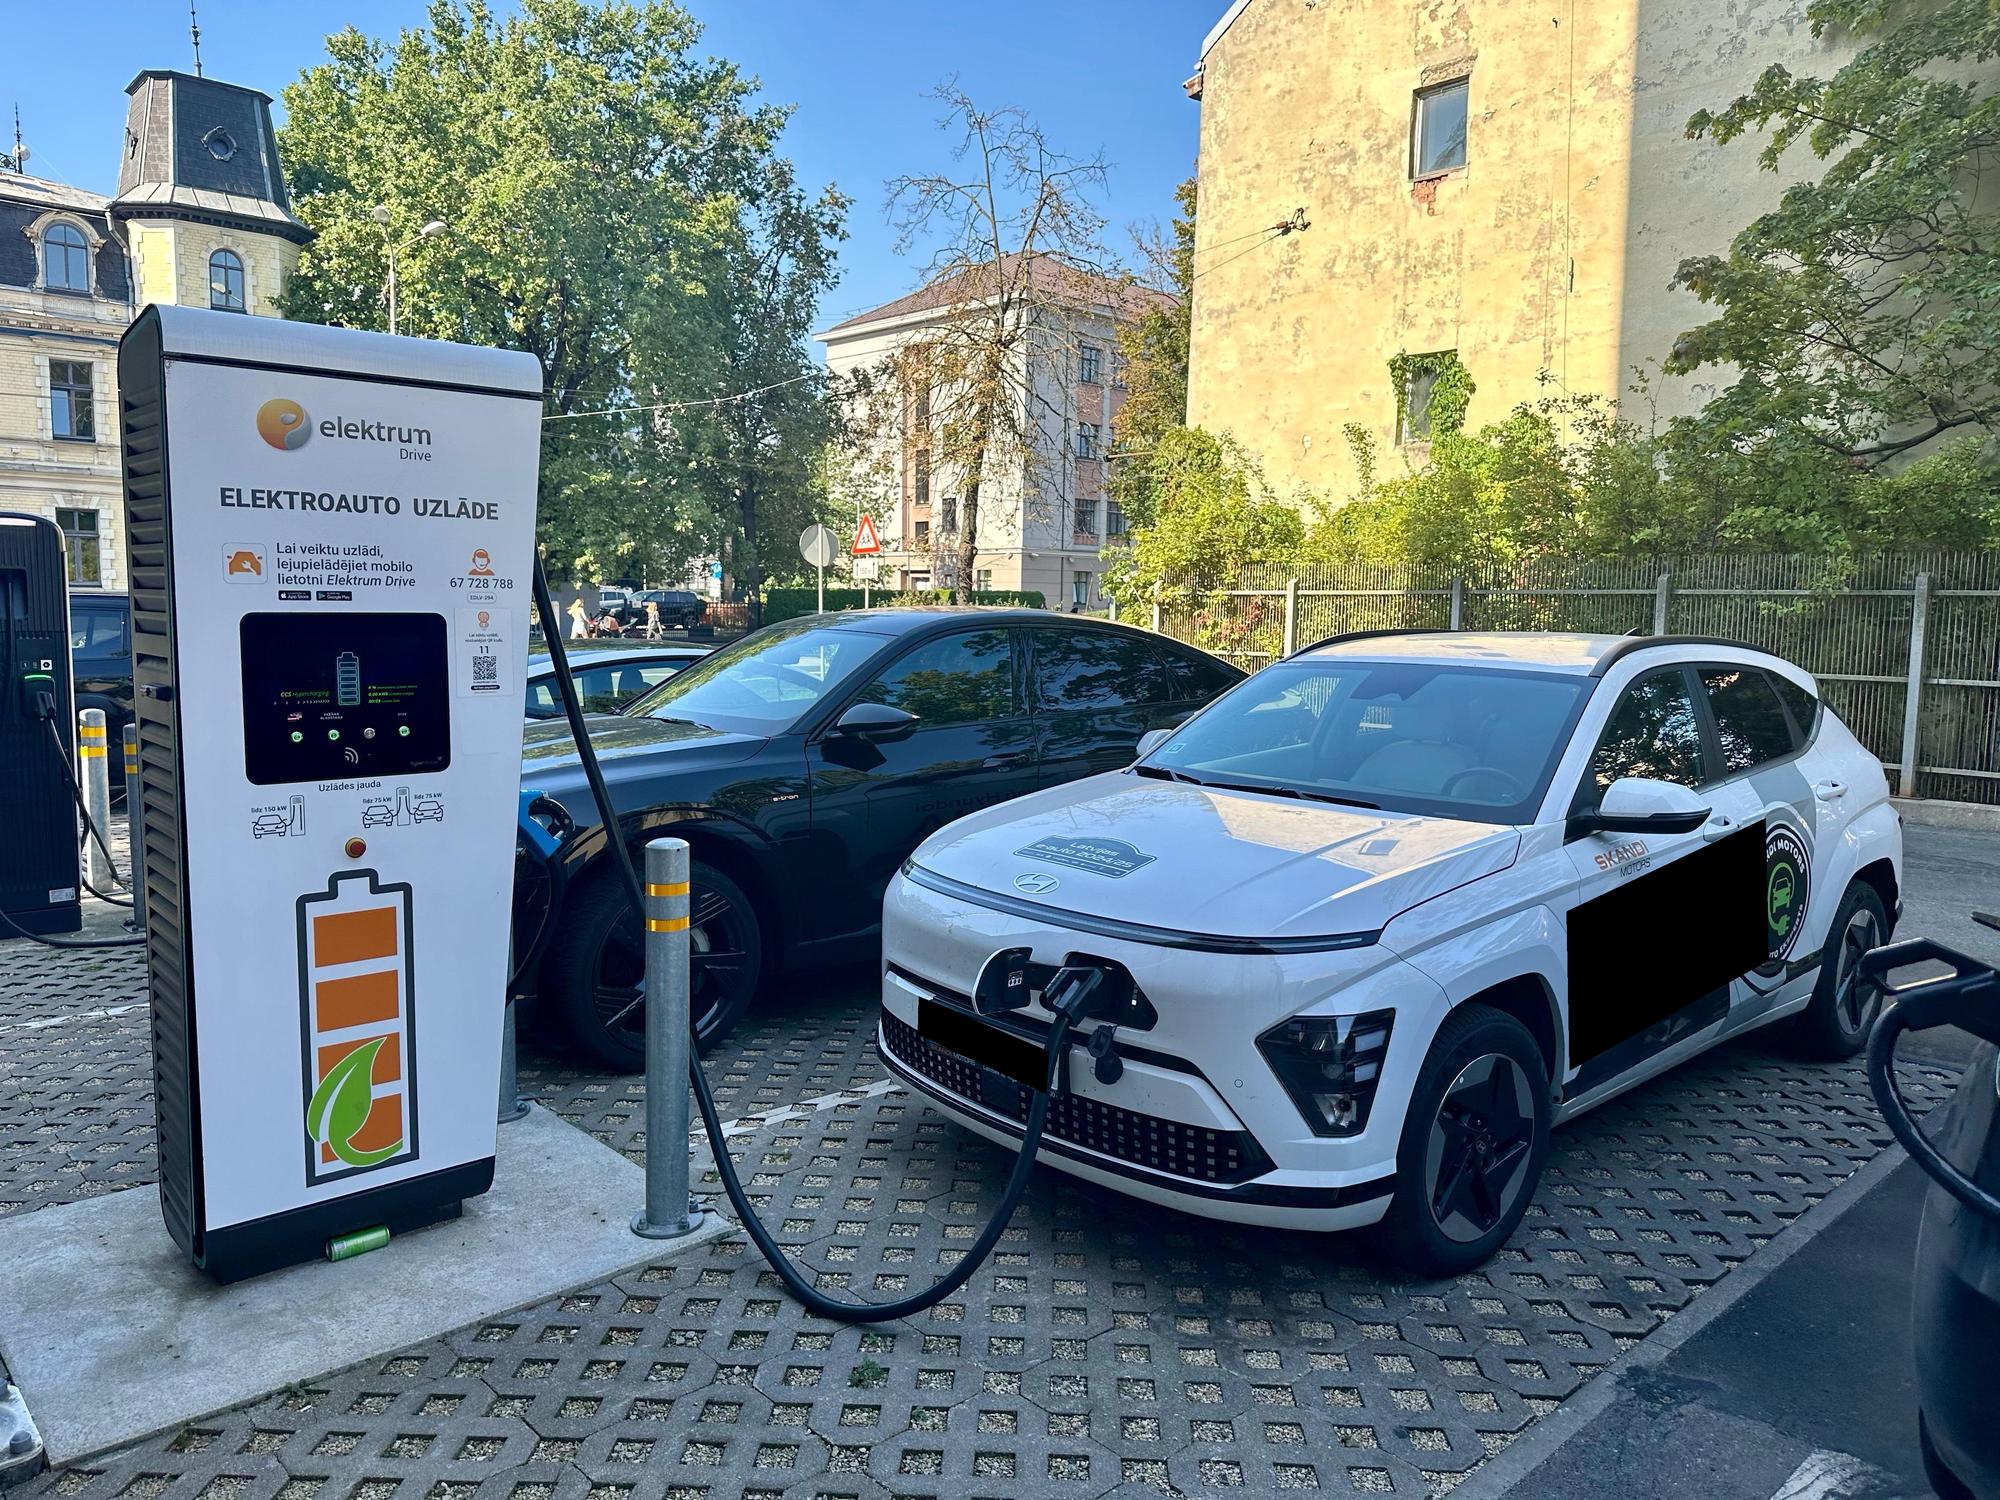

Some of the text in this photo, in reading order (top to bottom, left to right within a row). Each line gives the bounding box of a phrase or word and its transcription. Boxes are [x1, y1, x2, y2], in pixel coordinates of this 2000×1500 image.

[319, 416, 432, 446] elektrum
[399, 448, 432, 462] Drive
[219, 486, 499, 521] ELEKTROAUTO UZLĀDE
[276, 542, 384, 559] Lai veiktu uzlādi,
[276, 557, 413, 573] lejupielādējiet mobilo
[277, 573, 416, 587] lietotni Elektrum Drive
[449, 577, 514, 589] 67 728 788
[479, 645, 489, 654] 11
[318, 780, 382, 792] Uzlādes jauda
[264, 805, 276, 813] 150
[276, 804, 288, 812] kW
[1594, 839, 1650, 871] SKANDI
[1777, 838, 1806, 874] MOTORS
[1619, 857, 1651, 878] MOTORS
